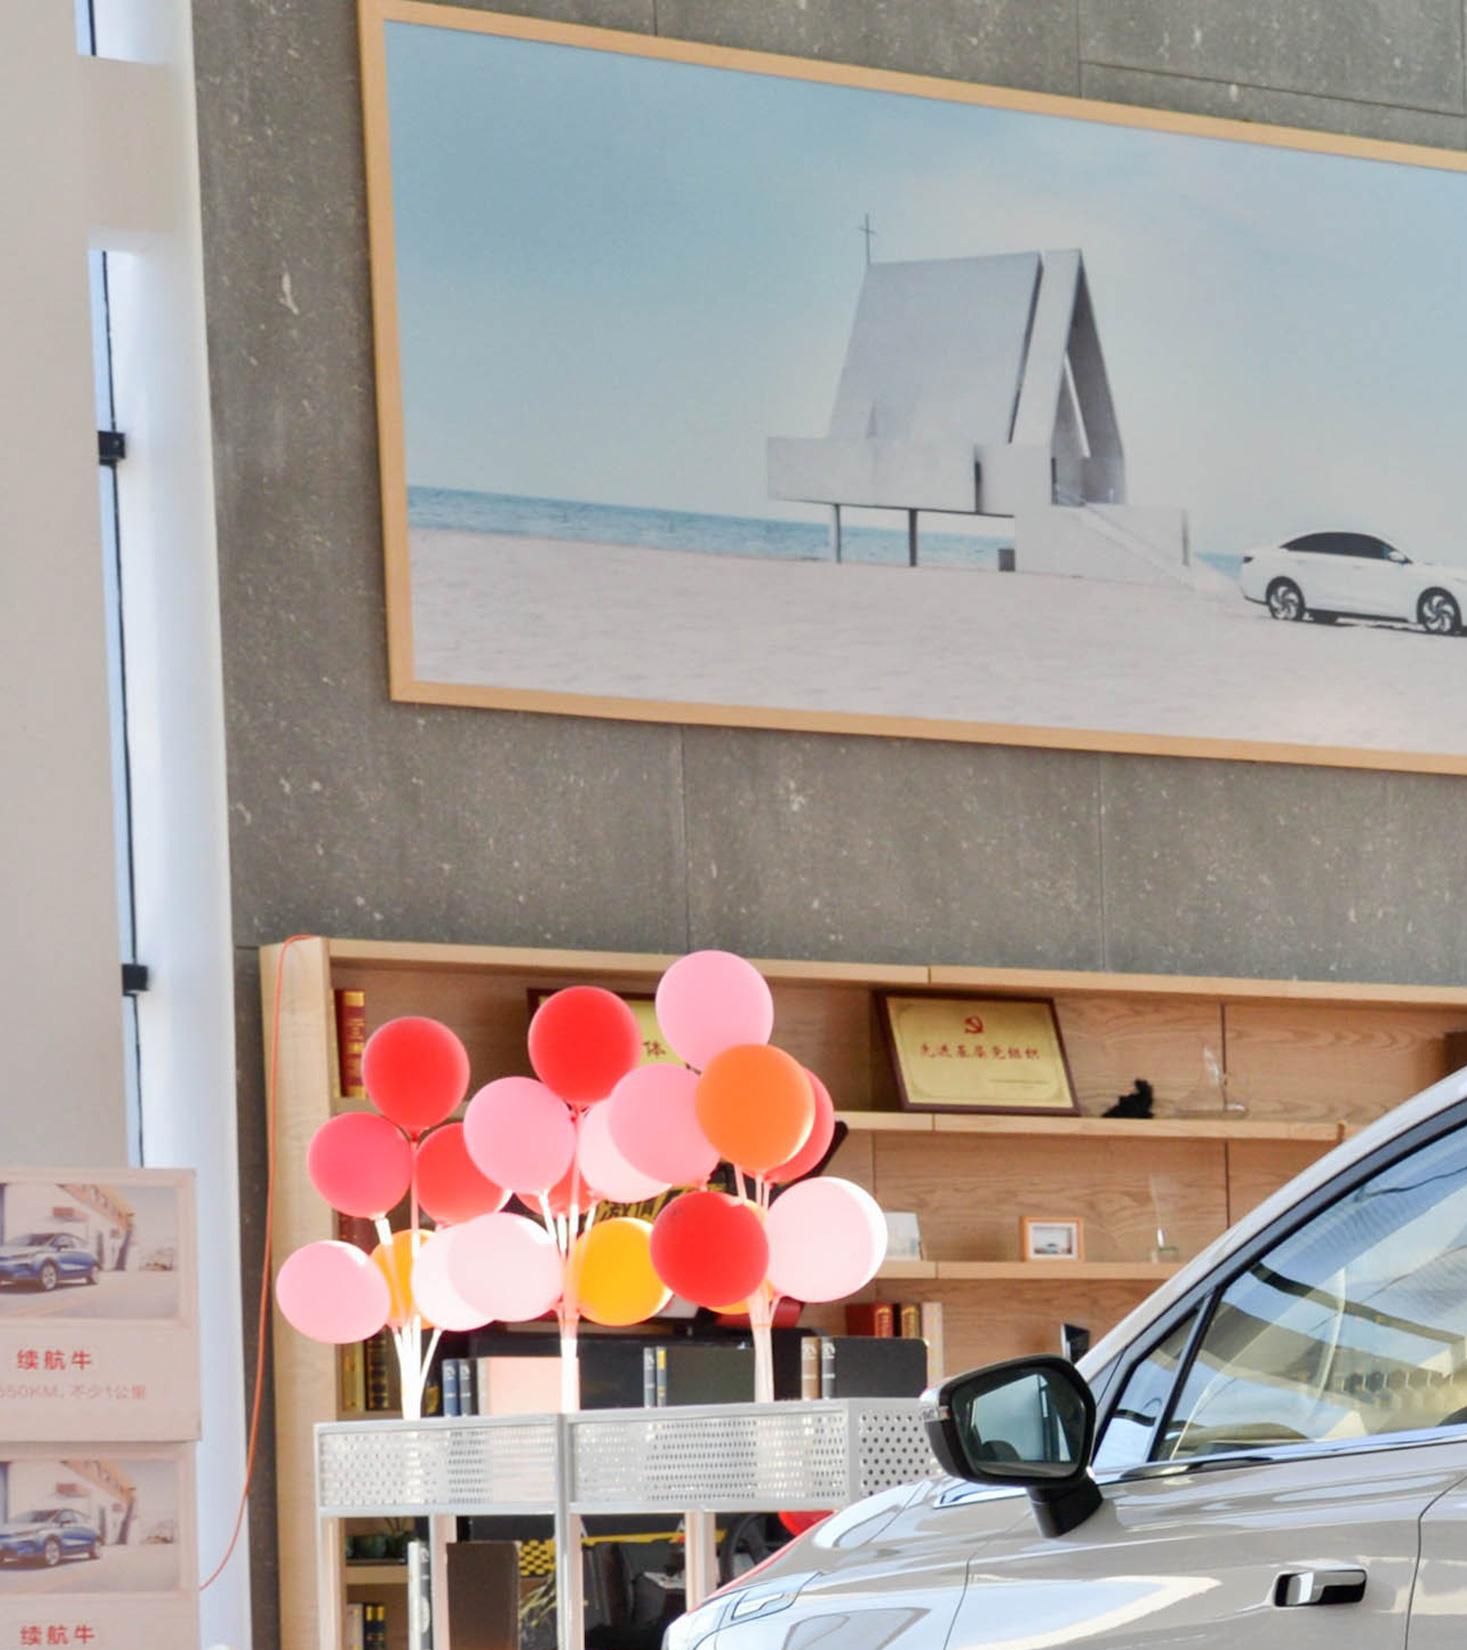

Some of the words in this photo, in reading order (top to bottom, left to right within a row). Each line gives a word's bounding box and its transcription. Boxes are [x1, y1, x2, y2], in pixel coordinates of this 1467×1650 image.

[17, 1349, 92, 1370] 续航牛
[20, 1625, 95, 1646] 续航牛
